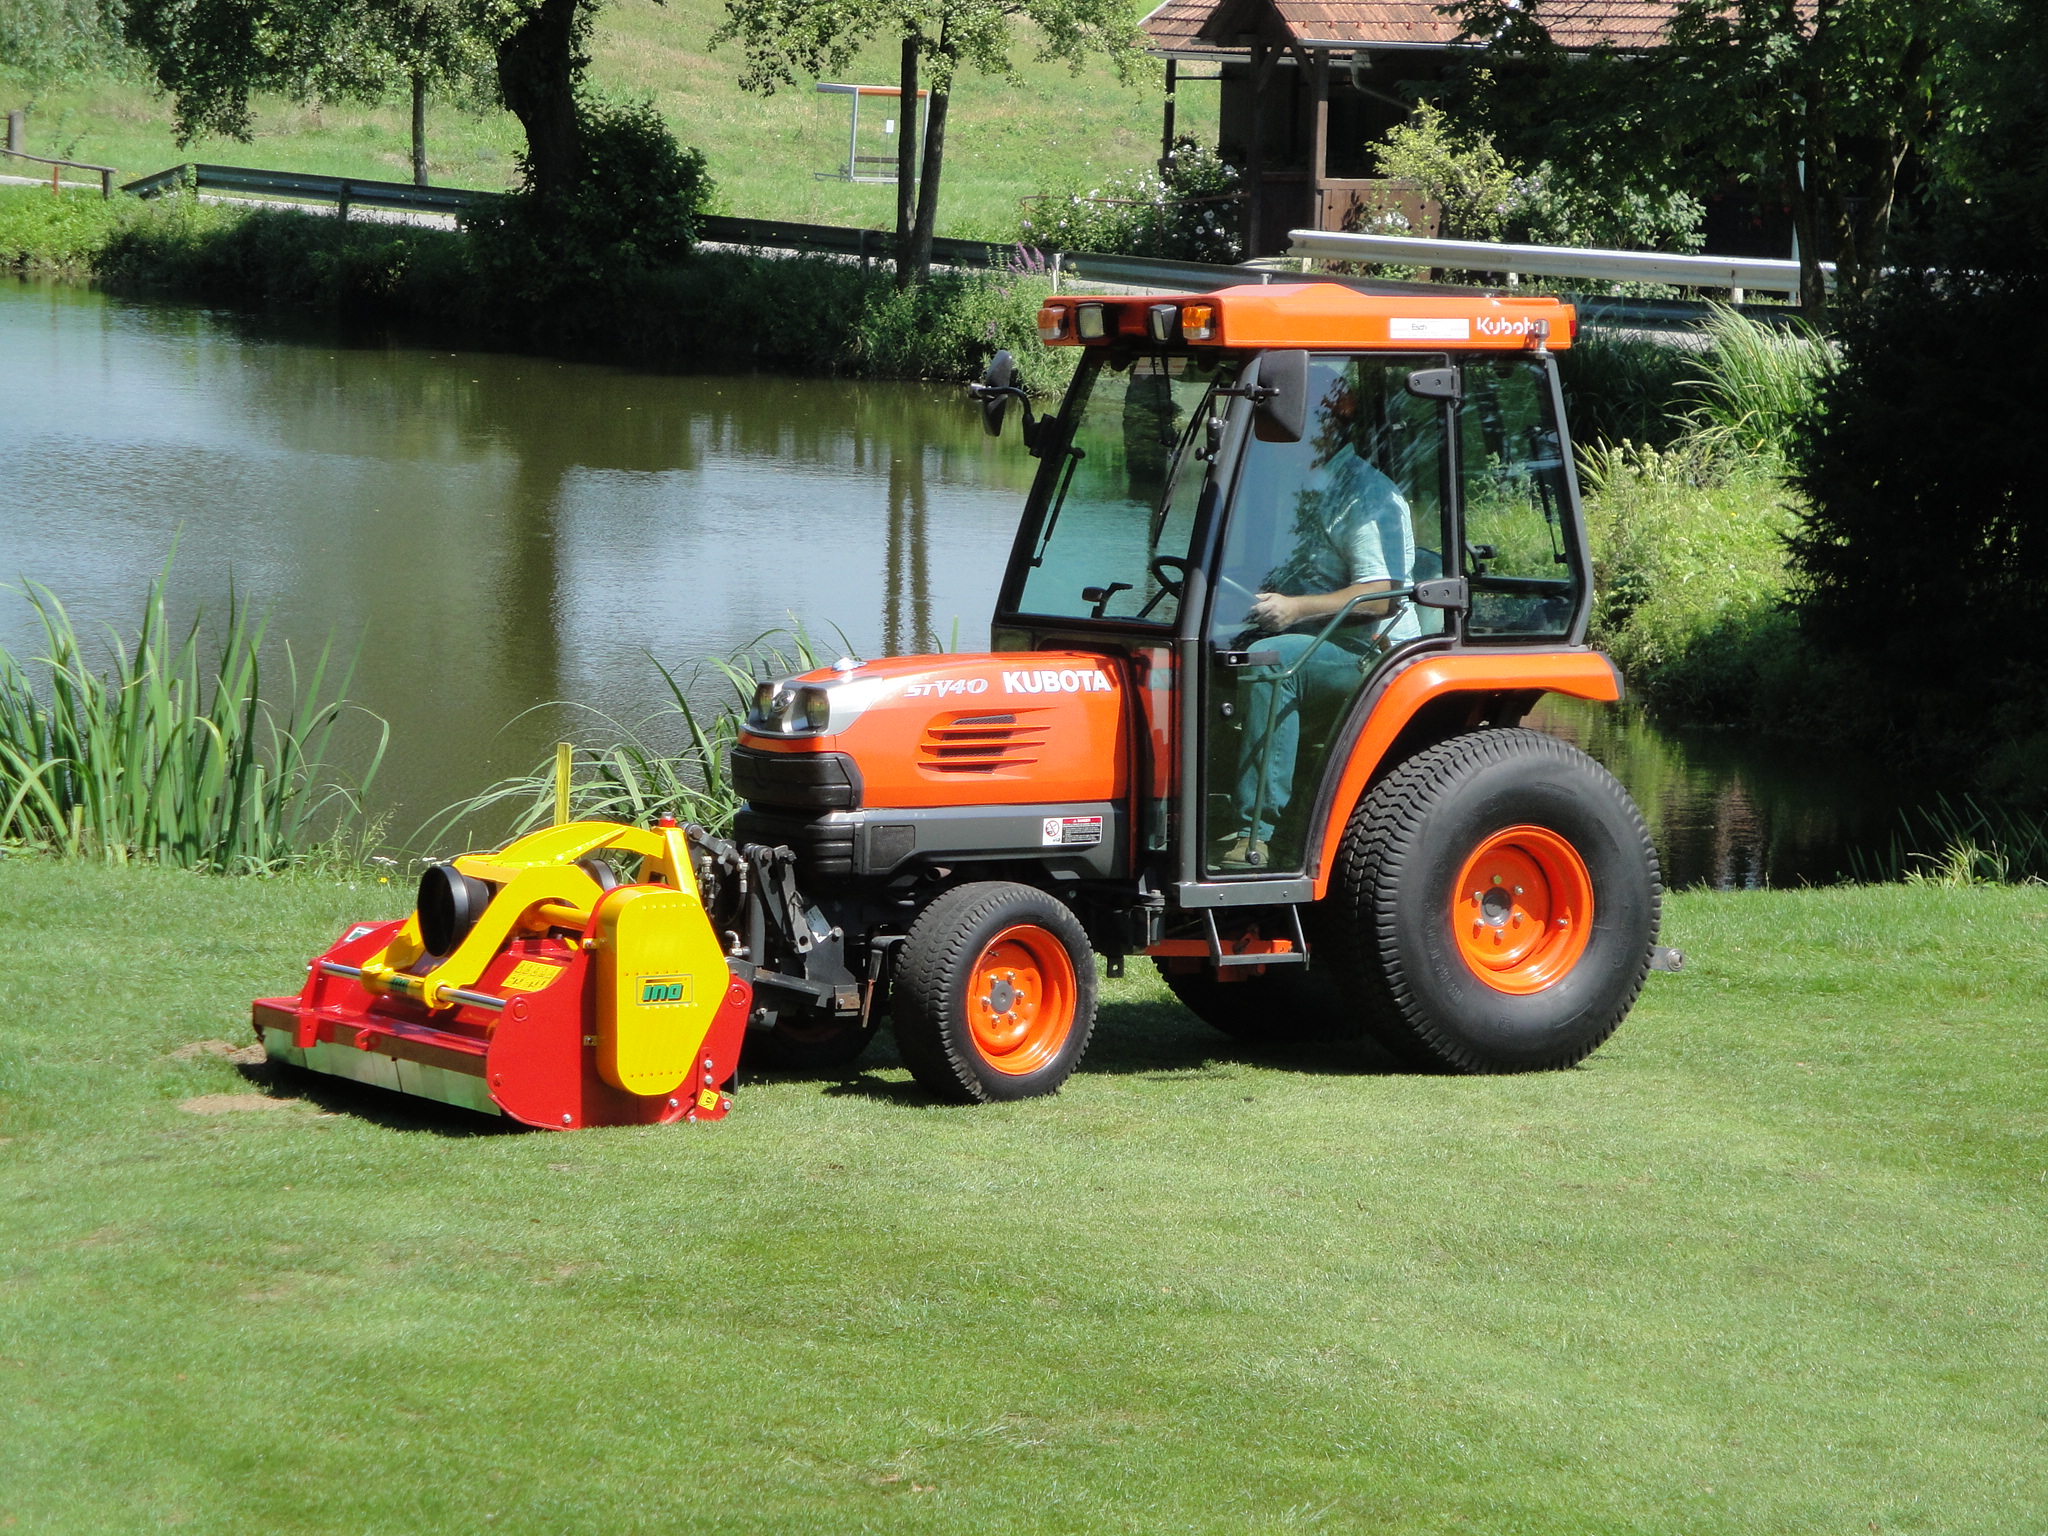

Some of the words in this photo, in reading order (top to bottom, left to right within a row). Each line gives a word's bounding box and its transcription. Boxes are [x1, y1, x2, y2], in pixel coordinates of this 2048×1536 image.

[1476, 316, 1538, 335] Kubot
[903, 678, 989, 698] STV40
[1002, 669, 1112, 694] KUBOTA
